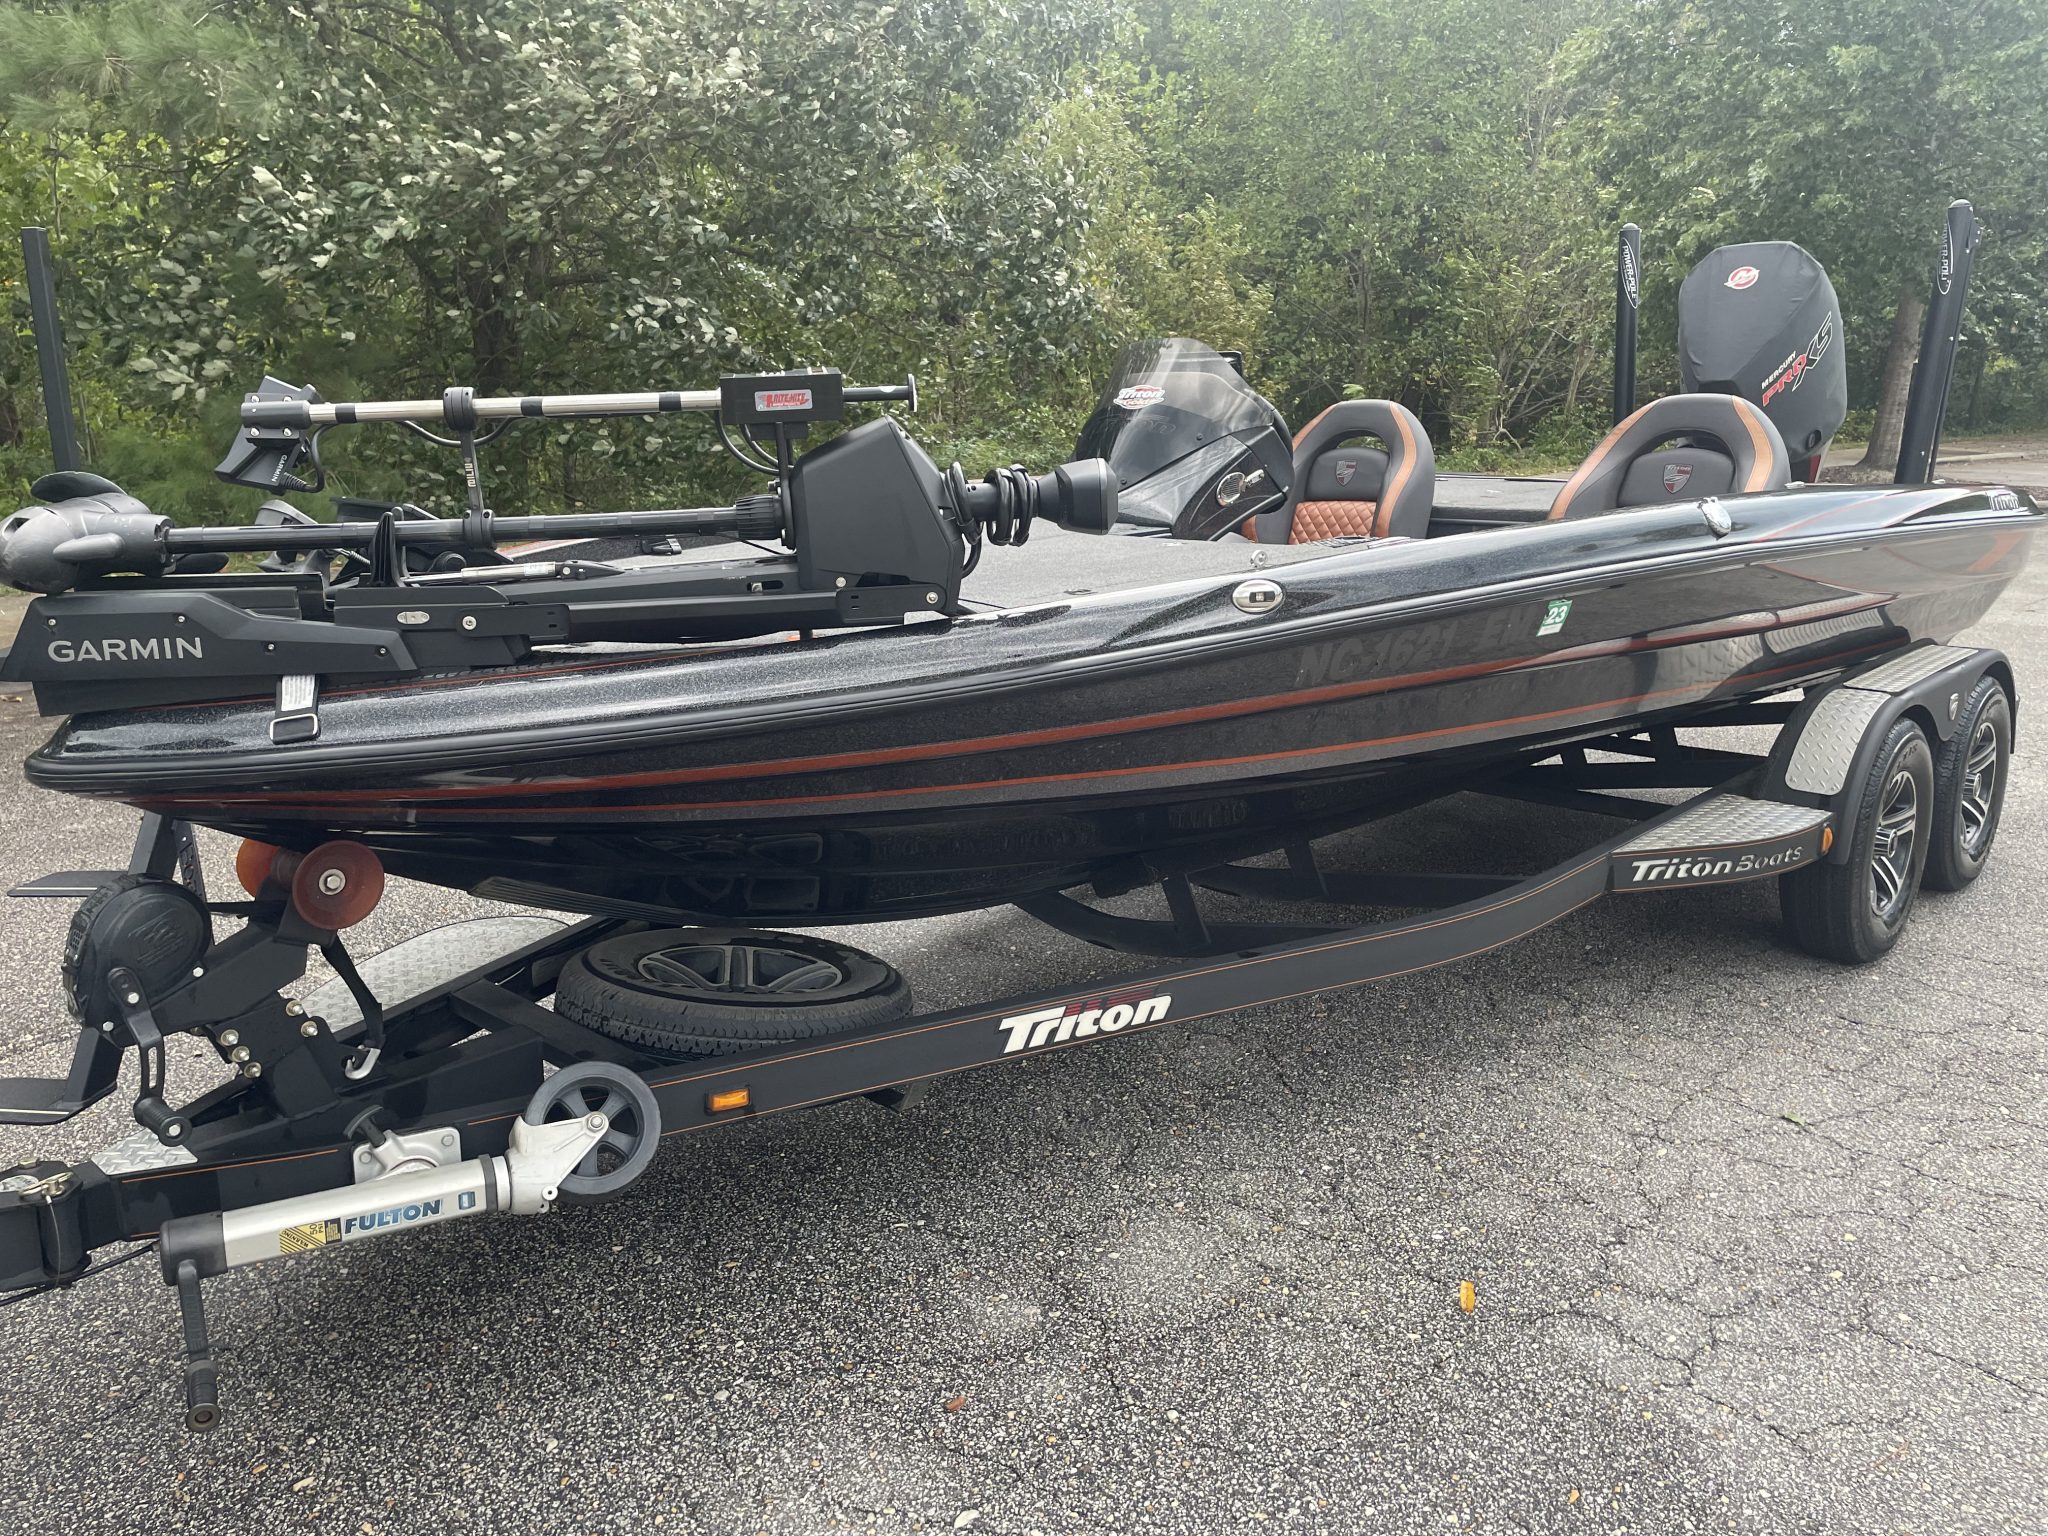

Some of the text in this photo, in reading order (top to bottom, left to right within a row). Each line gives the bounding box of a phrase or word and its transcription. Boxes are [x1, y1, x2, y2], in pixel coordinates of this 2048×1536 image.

[1622, 245, 1637, 299] POWER-POLE
[1761, 350, 1796, 390] MERCURY
[271, 454, 288, 482] GARMIN
[1543, 605, 1568, 625] 23
[47, 637, 203, 663] GARMIN
[1631, 846, 1803, 882] Triton Boats
[999, 995, 1172, 1054] Triton
[344, 1199, 441, 1234] FULTON
[281, 1230, 309, 1248] WARNING
